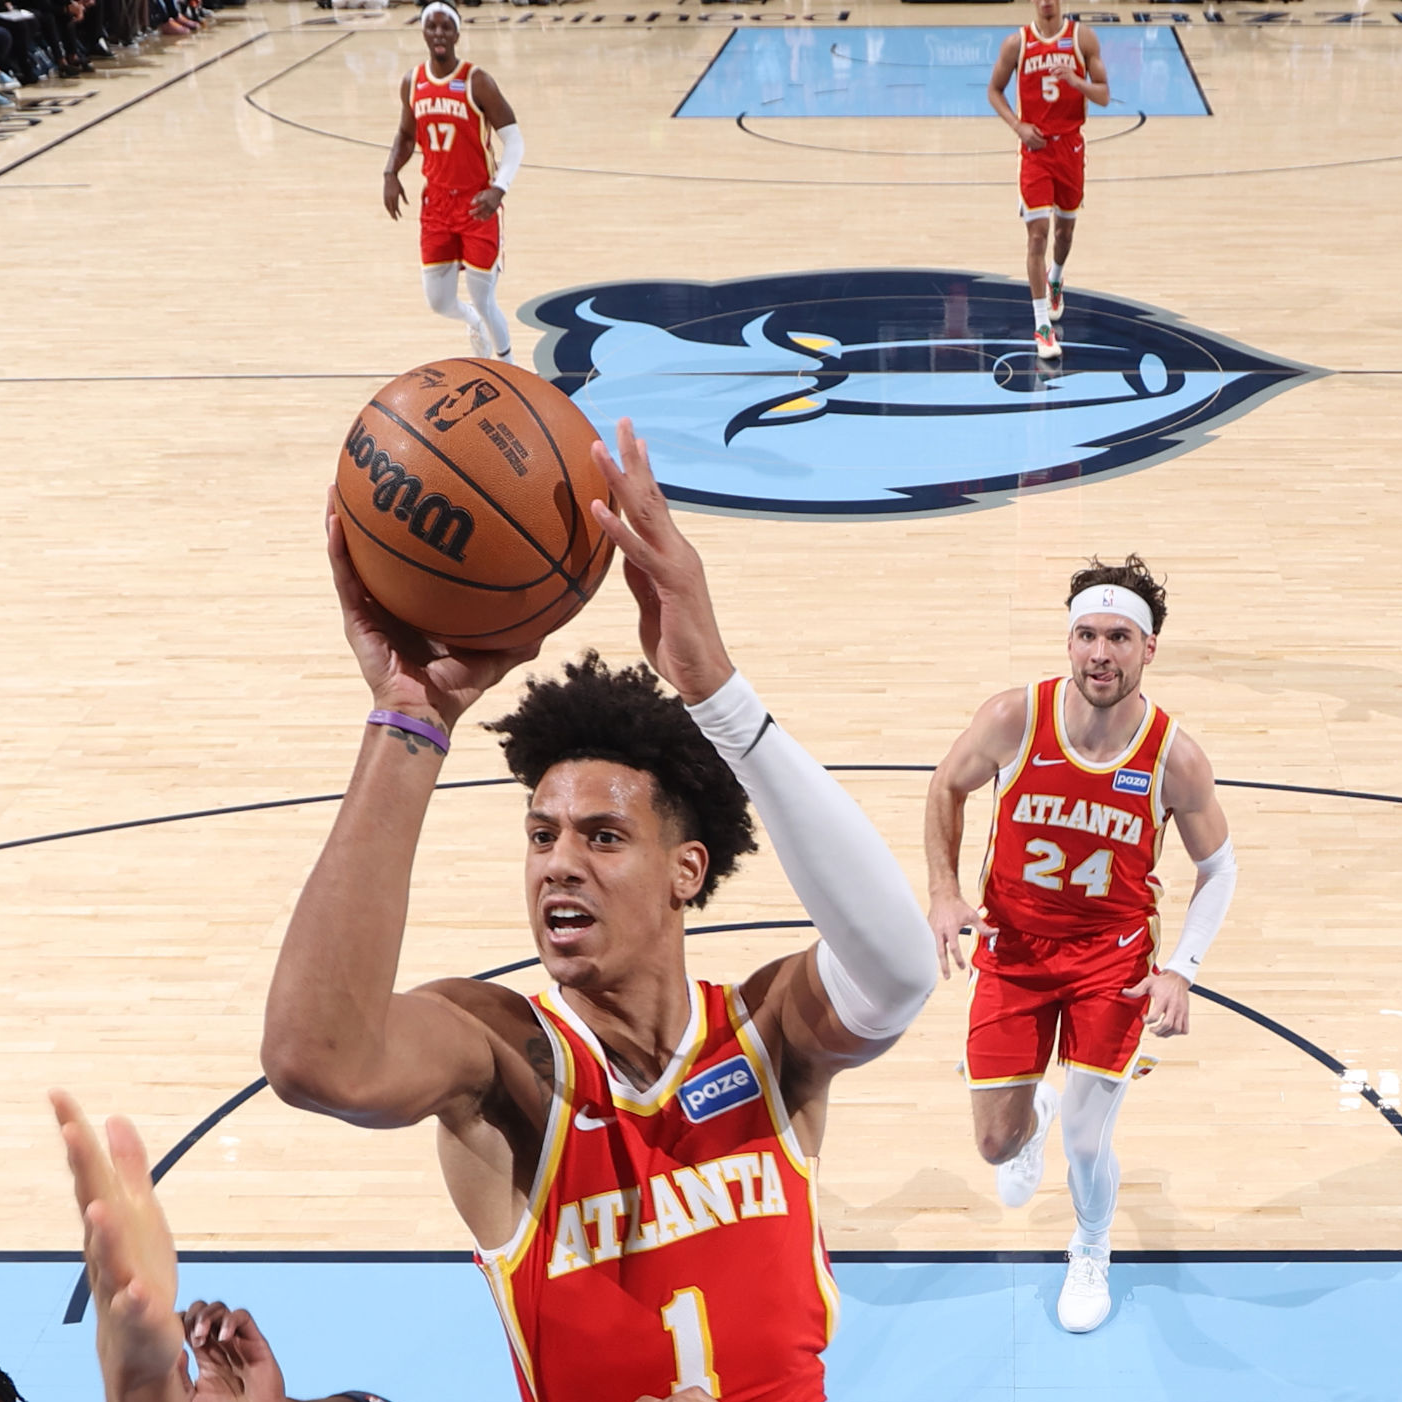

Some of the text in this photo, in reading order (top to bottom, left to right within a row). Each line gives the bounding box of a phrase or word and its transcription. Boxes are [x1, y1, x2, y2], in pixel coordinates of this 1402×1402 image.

[1024, 53, 1077, 75] ATLANTA
[1041, 75, 1060, 103] 5
[414, 97, 470, 121] ATLANTA
[426, 122, 456, 152] 17
[1117, 774, 1148, 788] paze
[1011, 792, 1144, 847] ATLANTA
[1021, 838, 1115, 898] 24
[685, 1069, 750, 1112] paze
[547, 1151, 789, 1280] ATLANTA
[661, 1285, 722, 1399] 1
